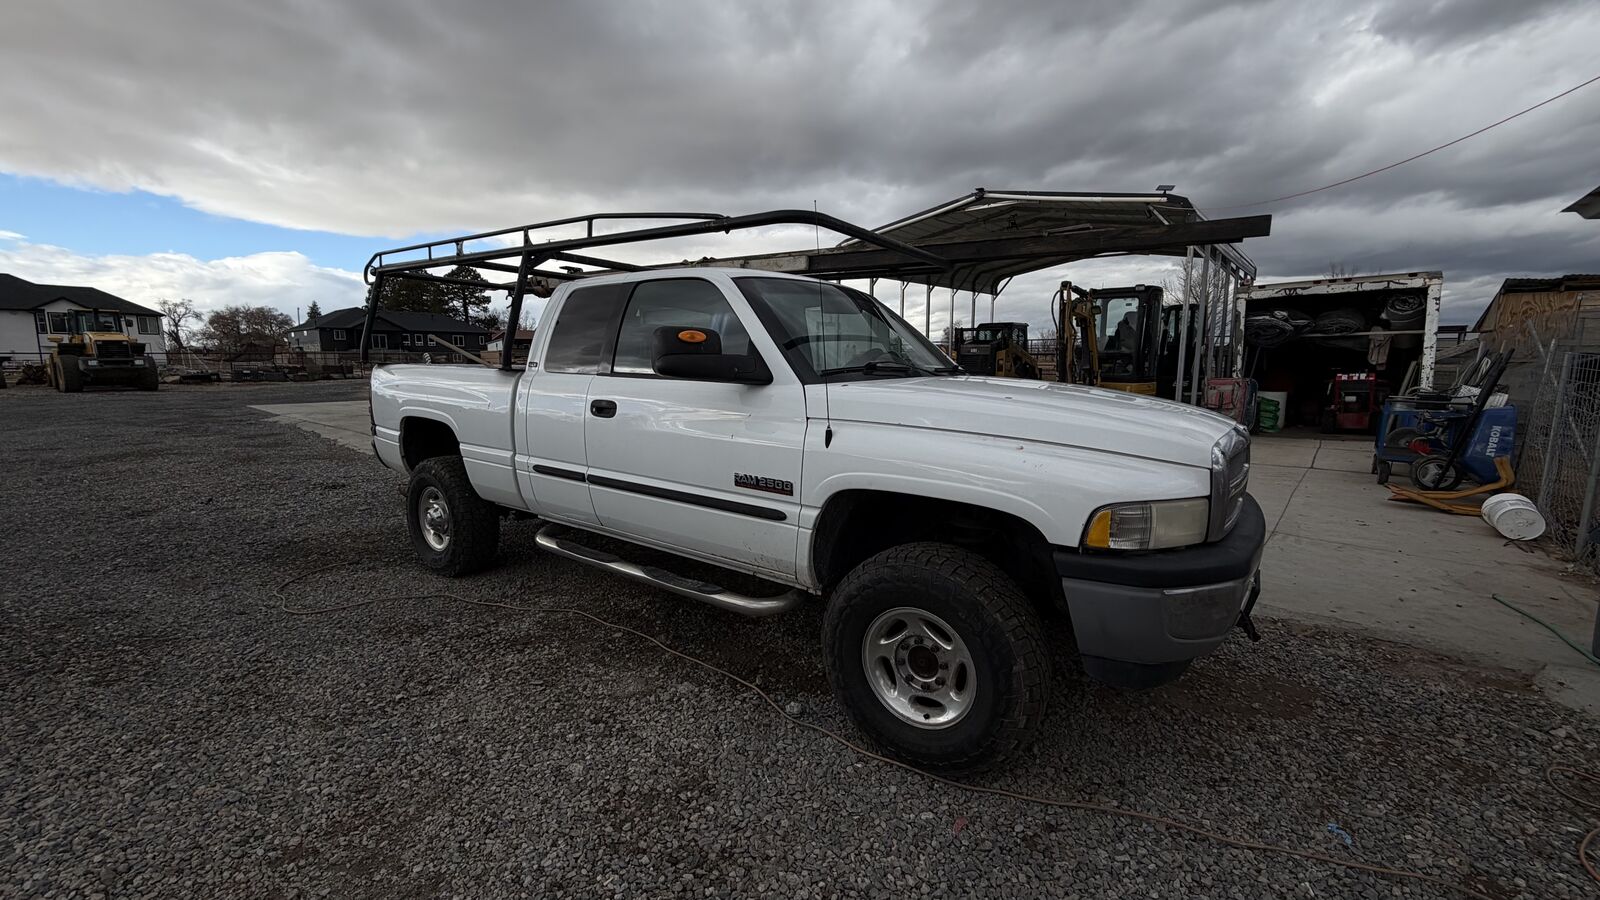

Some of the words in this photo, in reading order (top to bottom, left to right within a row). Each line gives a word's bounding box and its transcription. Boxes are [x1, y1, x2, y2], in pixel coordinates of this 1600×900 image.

[1485, 425, 1502, 457] KOBALT
[734, 473, 757, 485] RAM
[759, 478, 792, 491] 2500
